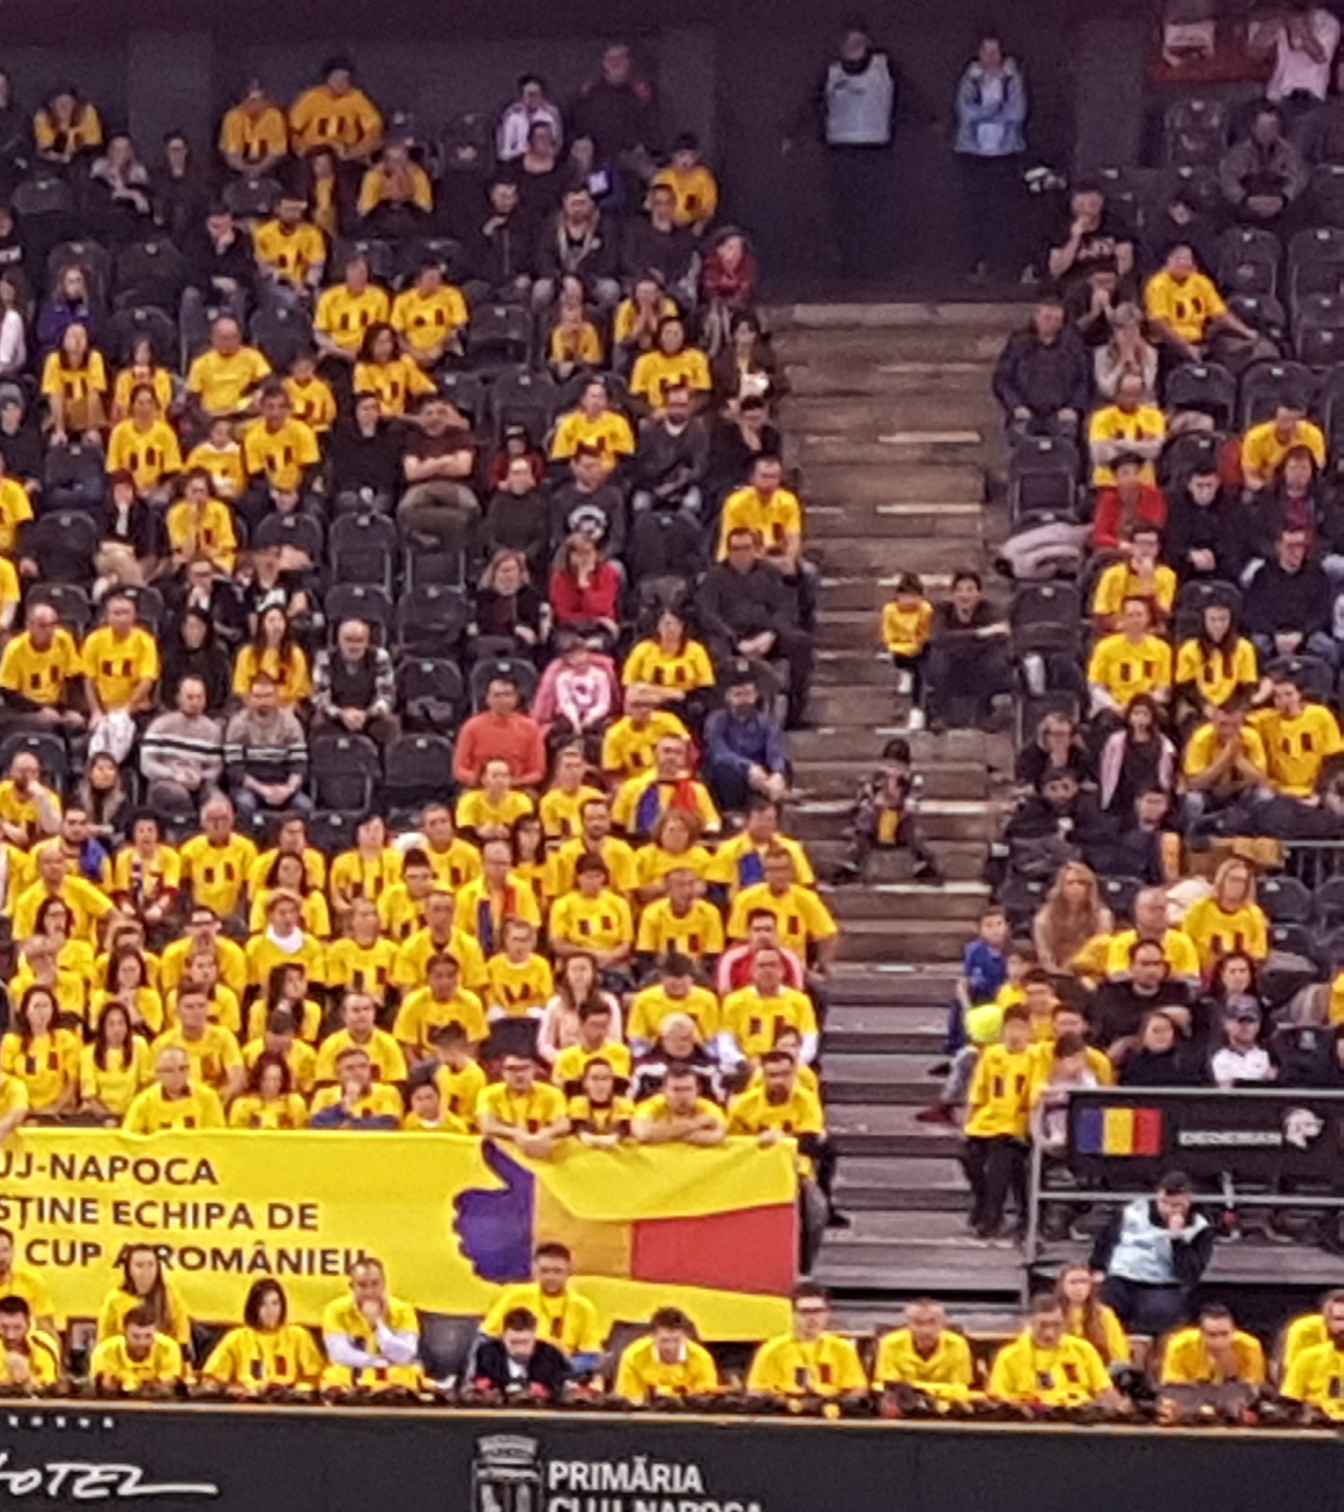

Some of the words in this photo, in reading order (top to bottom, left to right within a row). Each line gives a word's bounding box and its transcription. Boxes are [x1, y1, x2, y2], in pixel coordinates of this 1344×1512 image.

[113, 1200, 255, 1230] ECHIPA
[268, 1202, 319, 1232] DE
[25, 1238, 102, 1268] CUP
[548, 1455, 706, 1494] PRIMĂRIA
